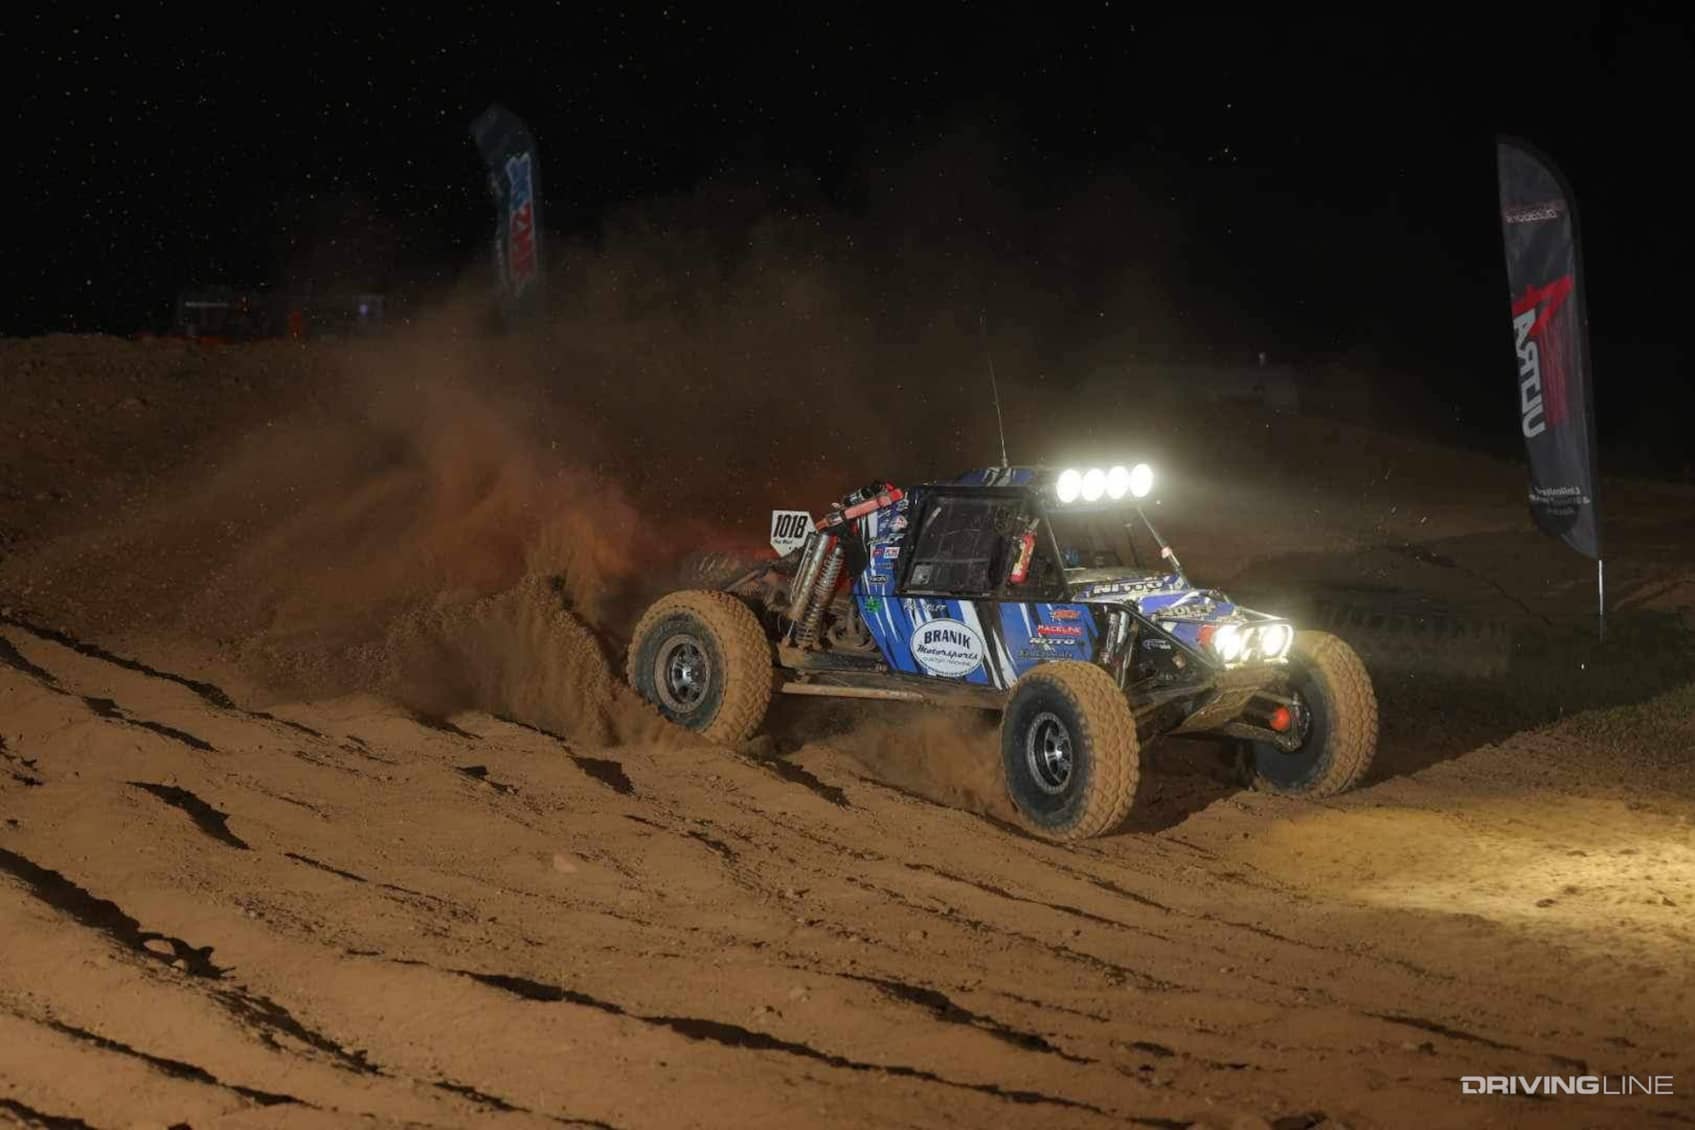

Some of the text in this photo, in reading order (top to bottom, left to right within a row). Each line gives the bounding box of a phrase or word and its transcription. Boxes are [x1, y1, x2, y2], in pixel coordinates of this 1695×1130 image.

[773, 514, 808, 538] 1018
[924, 629, 971, 649] BRANIK
[917, 644, 978, 660] Motorsports
